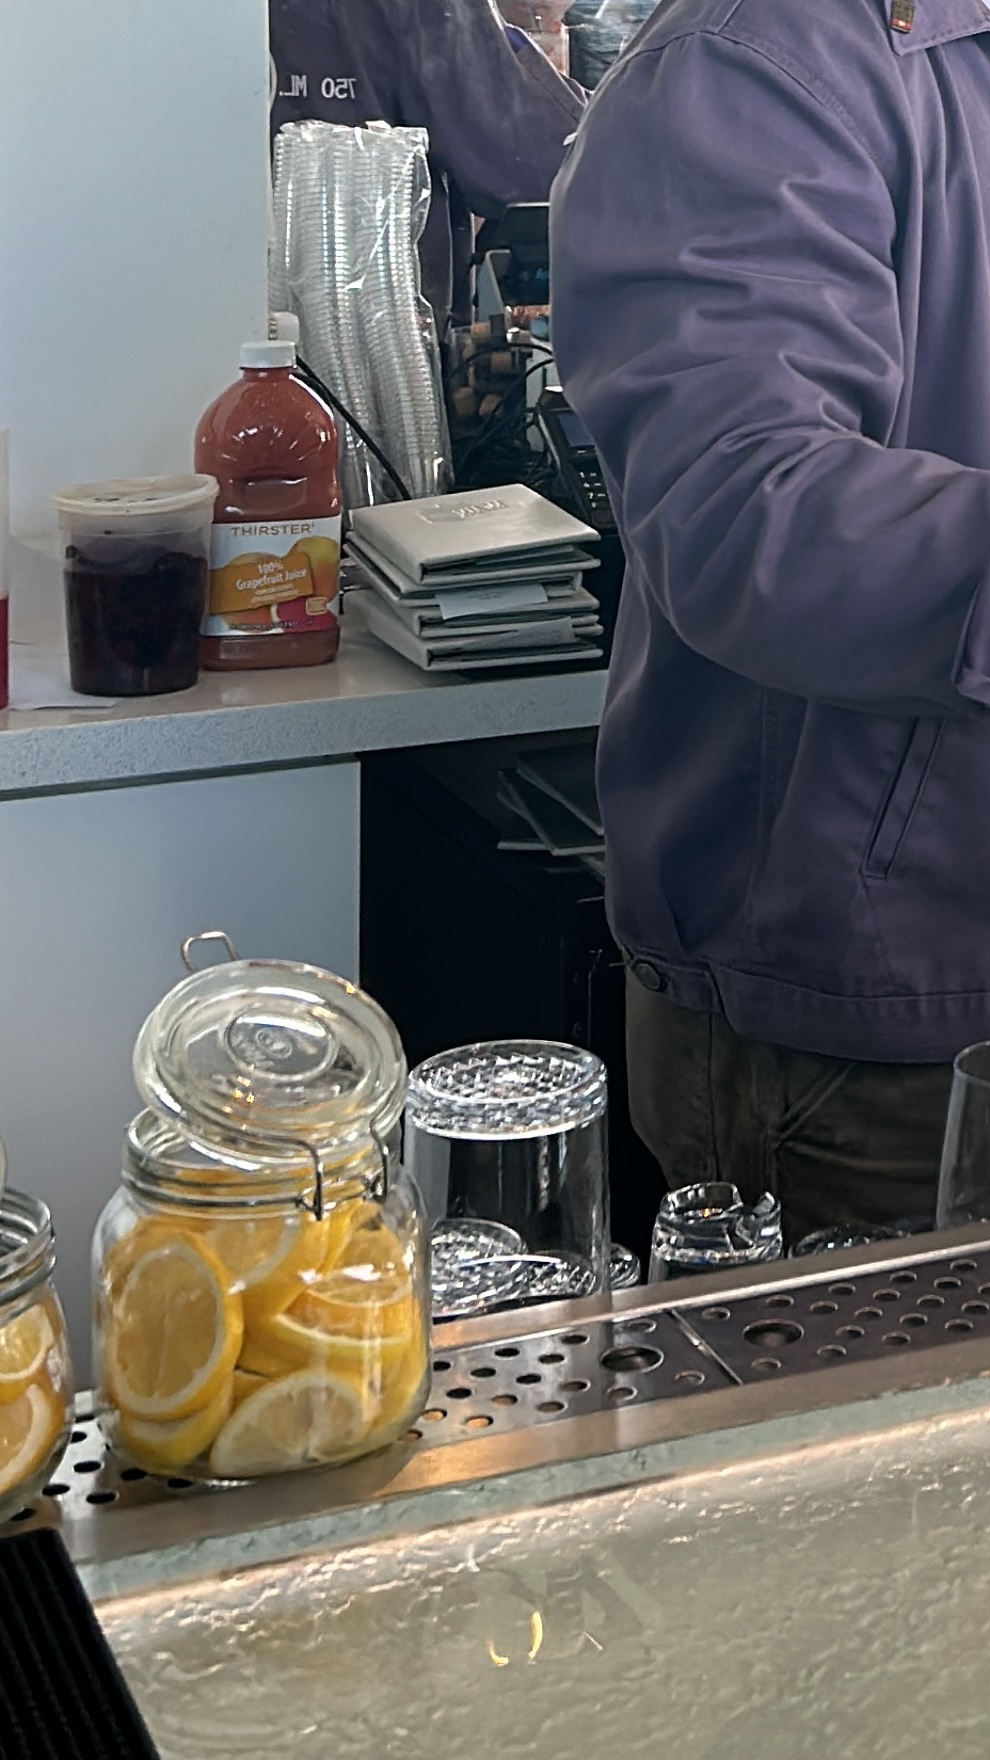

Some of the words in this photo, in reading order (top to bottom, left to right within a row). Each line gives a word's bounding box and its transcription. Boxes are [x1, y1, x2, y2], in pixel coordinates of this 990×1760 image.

[231, 523, 312, 537] THIRSTER
[257, 561, 284, 574] 100%
[236, 573, 284, 590] Grapefruit
[285, 568, 307, 581] Juice
